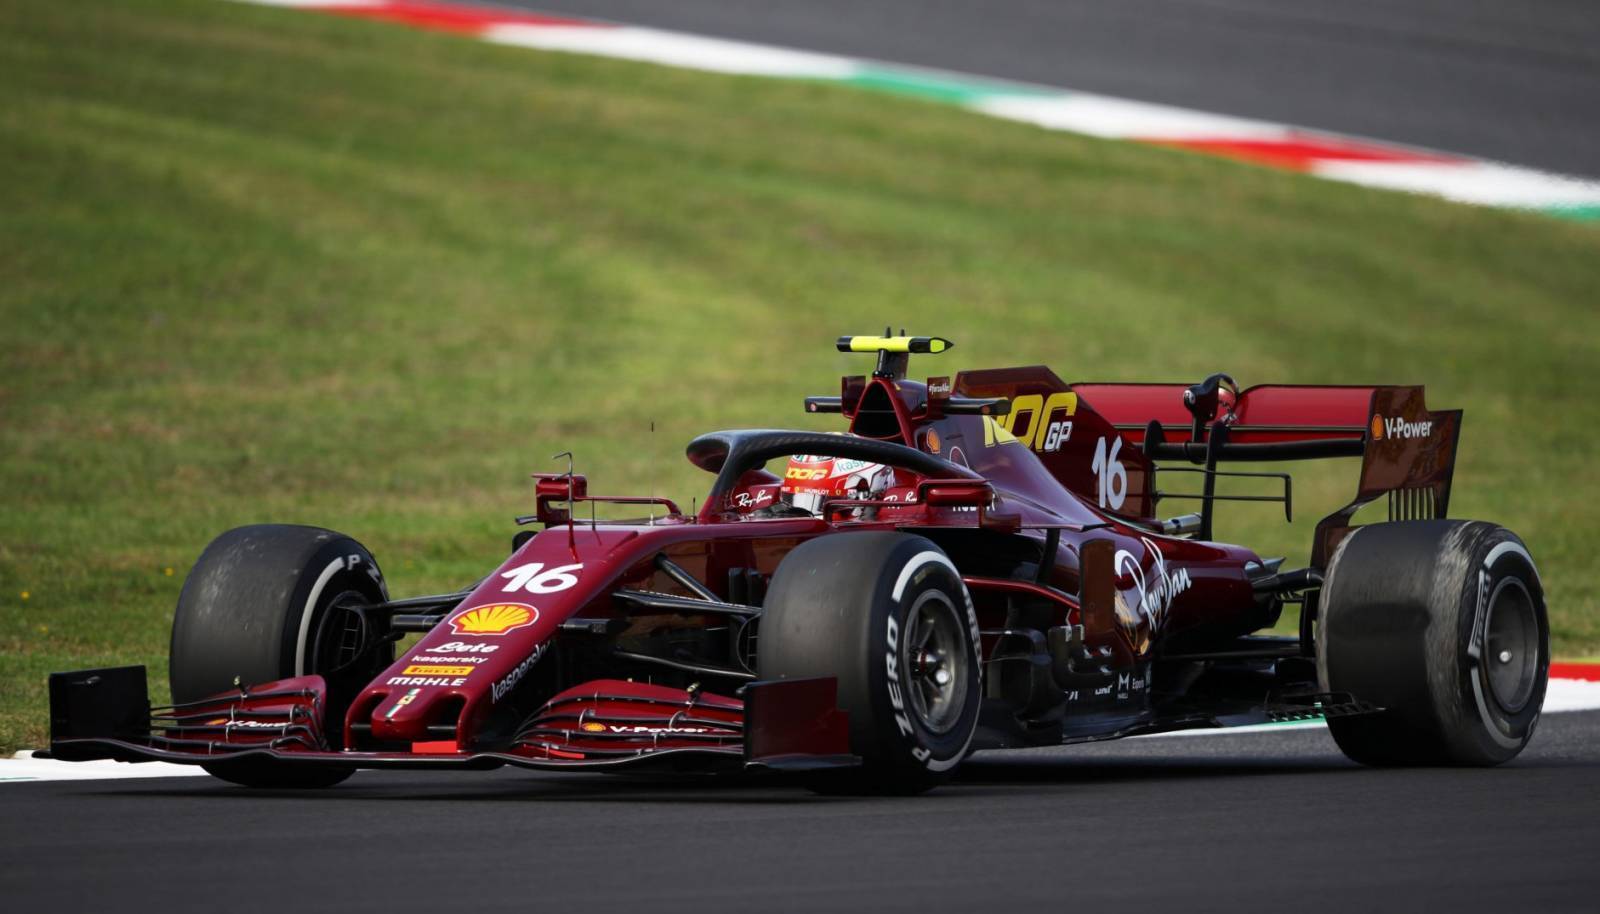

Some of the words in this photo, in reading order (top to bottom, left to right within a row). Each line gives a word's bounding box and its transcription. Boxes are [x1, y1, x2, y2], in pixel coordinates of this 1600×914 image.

[1044, 421, 1072, 451] GP
[1384, 416, 1432, 440] V-Power
[1091, 434, 1128, 510] 16
[501, 562, 584, 594] 16
[411, 655, 488, 664] kaspersky
[386, 676, 467, 687] MAHLE
[886, 614, 914, 737] ZERO
[610, 724, 708, 733] V-Power
